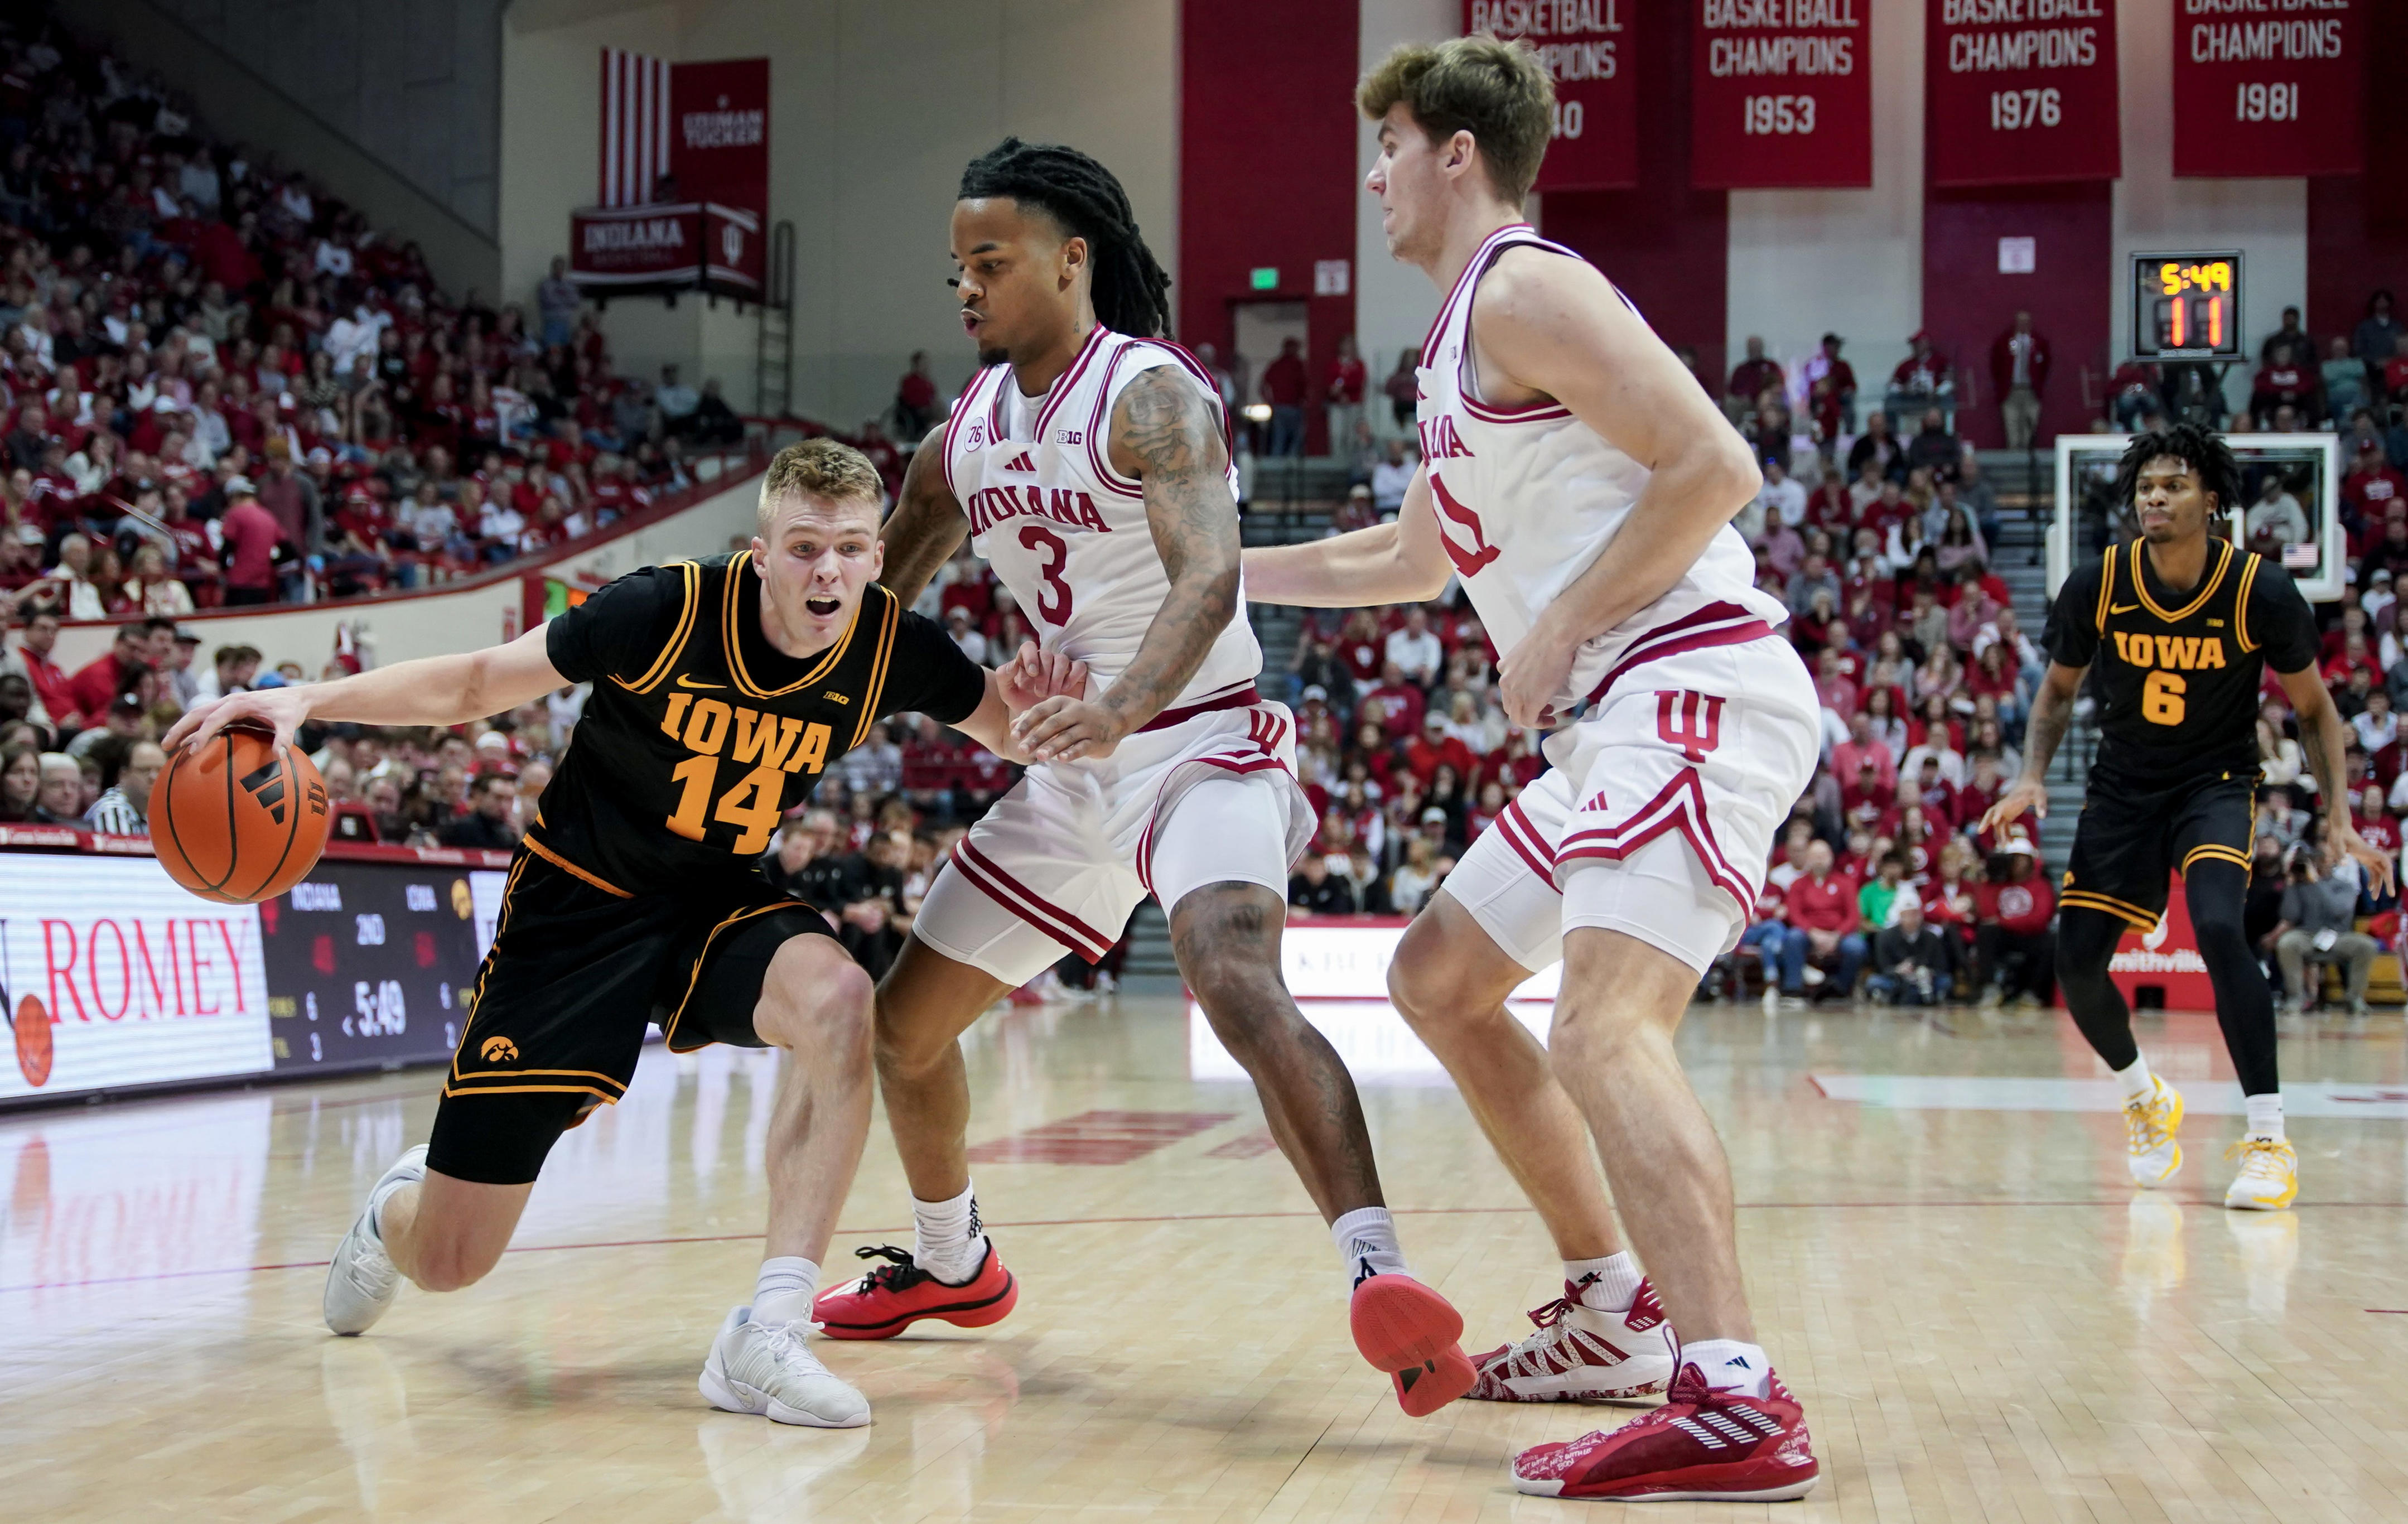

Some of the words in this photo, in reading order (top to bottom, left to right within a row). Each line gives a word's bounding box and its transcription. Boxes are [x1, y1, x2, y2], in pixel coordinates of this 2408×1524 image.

[1471, 0, 1623, 35] BASKETBALL
[1703, 0, 1859, 28] BASKETBALL
[1538, 40, 1616, 81] PIONS
[1710, 36, 1854, 77] CHAMPIONS
[1949, 27, 2097, 73] CHAMPIONS
[2192, 20, 2342, 63] CHAMPIONS
[1745, 95, 1816, 135] 1953
[1991, 87, 2062, 131] 1976
[2236, 82, 2299, 121] 1981
[584, 219, 684, 251] INDIANA
[2160, 262, 2231, 295] 5:49
[2171, 296, 2222, 347] 11
[968, 485, 1113, 538] INDIANA
[1019, 525, 1073, 628] 3
[2114, 631, 2226, 669] IOWA
[2142, 670, 2187, 726] 6
[661, 692, 832, 774] IOWA
[665, 755, 785, 855] 14
[40, 918, 249, 1024] ROMEY
[2107, 948, 2208, 973] mithville
[355, 980, 407, 1037] 5:49
